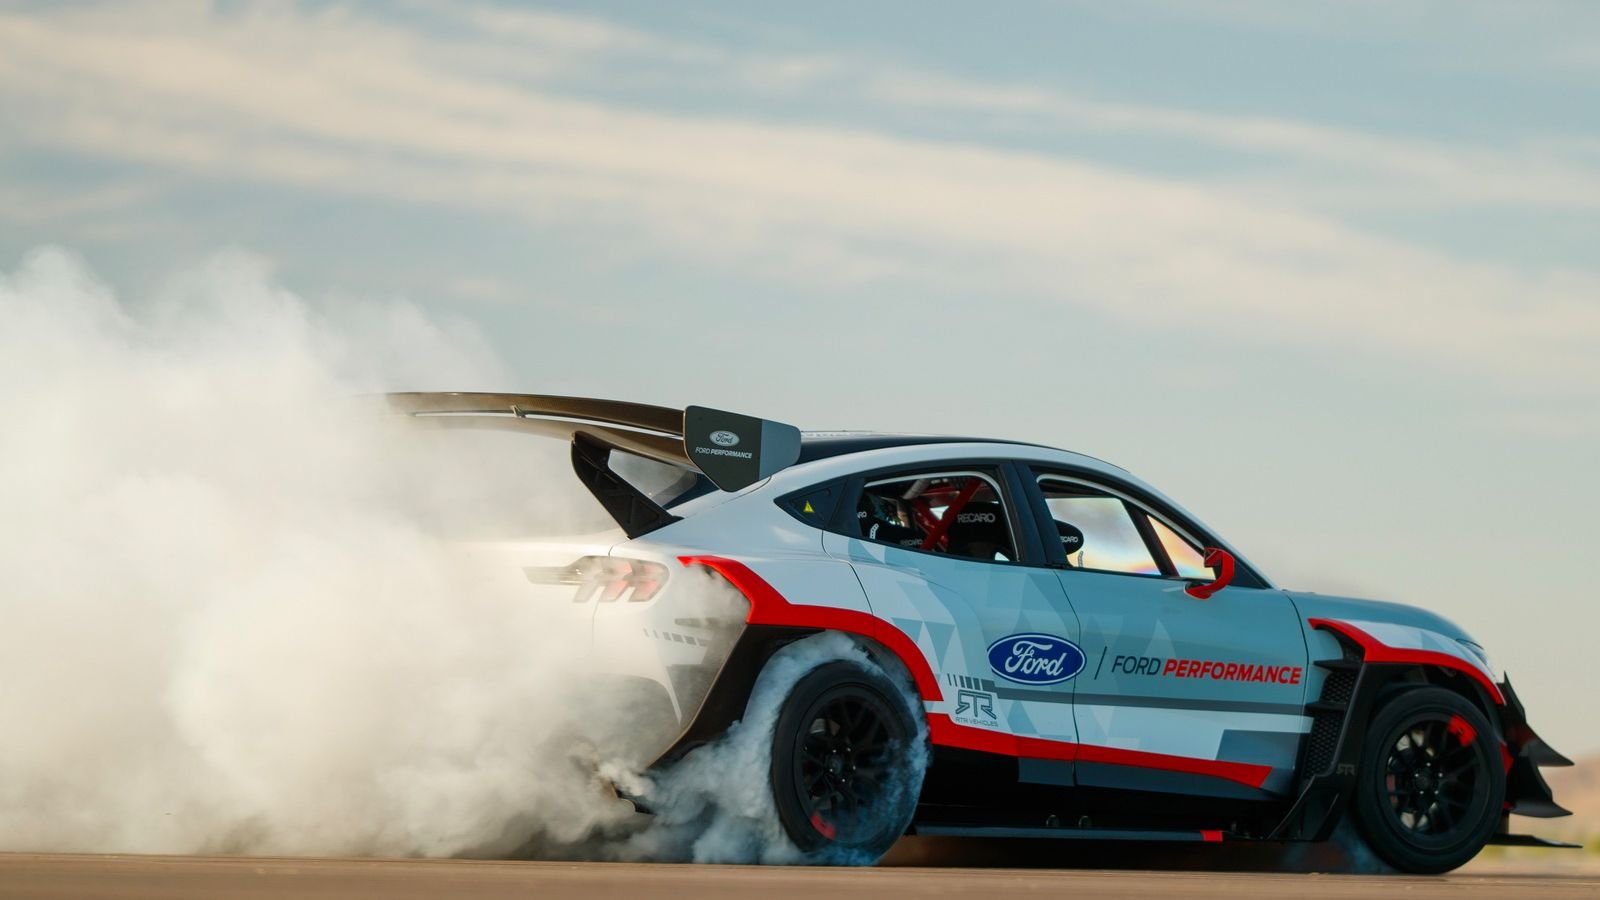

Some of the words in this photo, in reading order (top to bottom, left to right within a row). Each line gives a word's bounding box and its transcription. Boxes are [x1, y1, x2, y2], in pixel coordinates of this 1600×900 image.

[715, 432, 733, 443] Ford
[711, 449, 752, 459] PERFORMANCE
[957, 513, 996, 523] RECARO
[1060, 535, 1079, 543] ECARO
[1004, 640, 1067, 677] Ford
[1111, 655, 1162, 676] FORD
[1162, 658, 1303, 685] PERFORMANCE
[969, 719, 998, 727] VEHICLES
